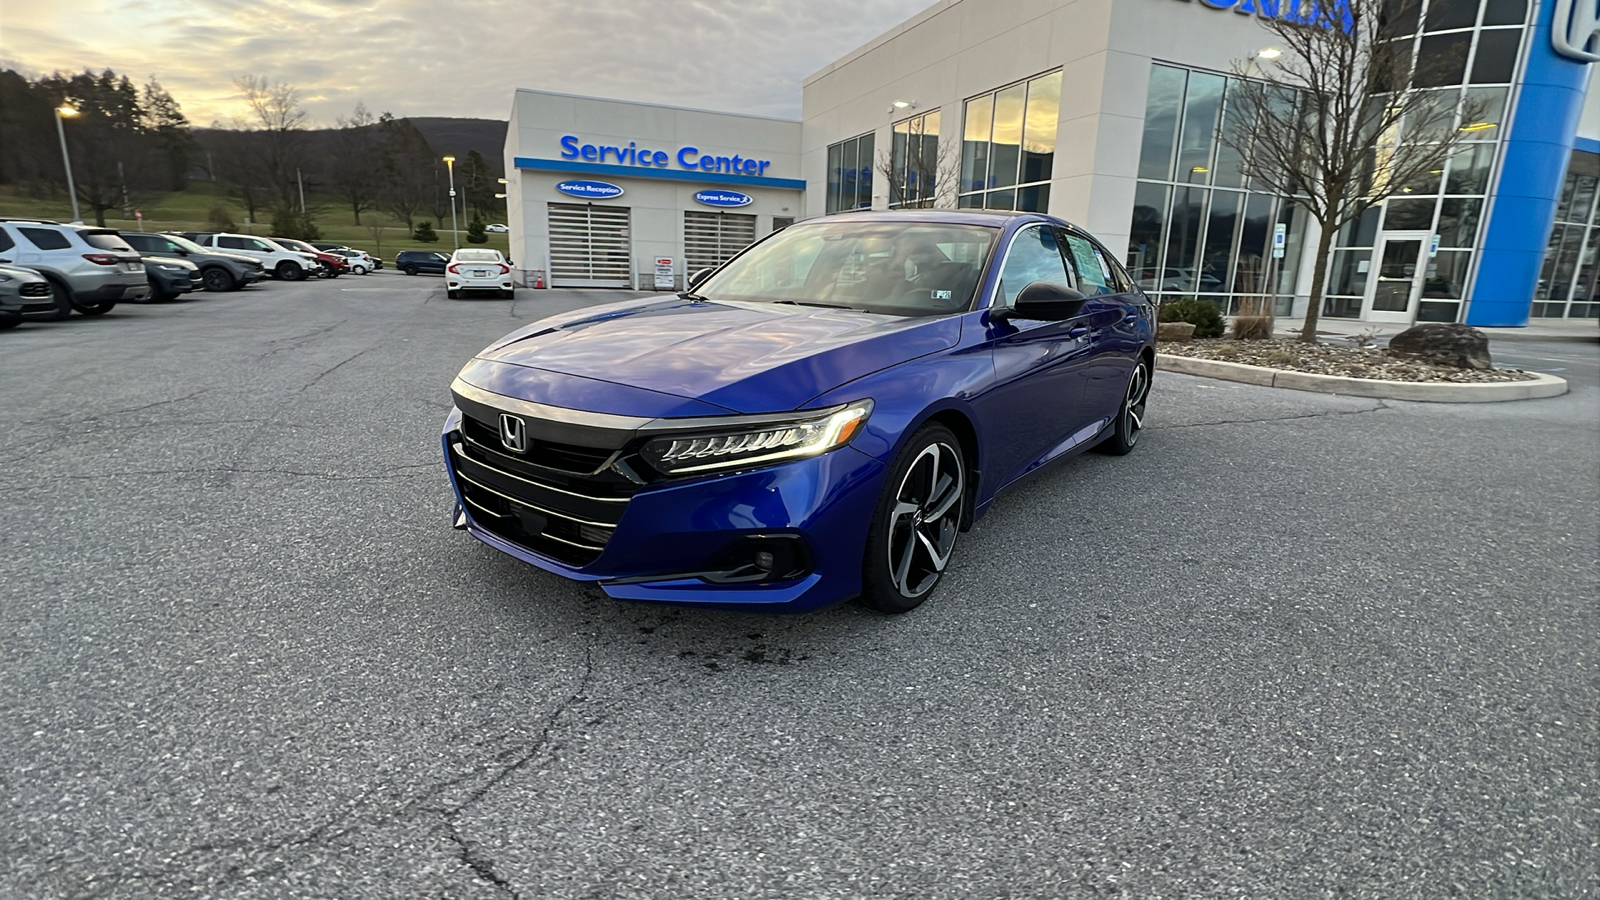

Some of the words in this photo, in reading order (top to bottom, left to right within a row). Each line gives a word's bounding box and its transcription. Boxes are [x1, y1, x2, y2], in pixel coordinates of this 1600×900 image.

[560, 135, 669, 167] Service
[677, 146, 770, 175] Center
[560, 183, 585, 192] Service
[586, 185, 620, 194] Reception
[696, 193, 719, 201] Express
[719, 194, 741, 203] Service
